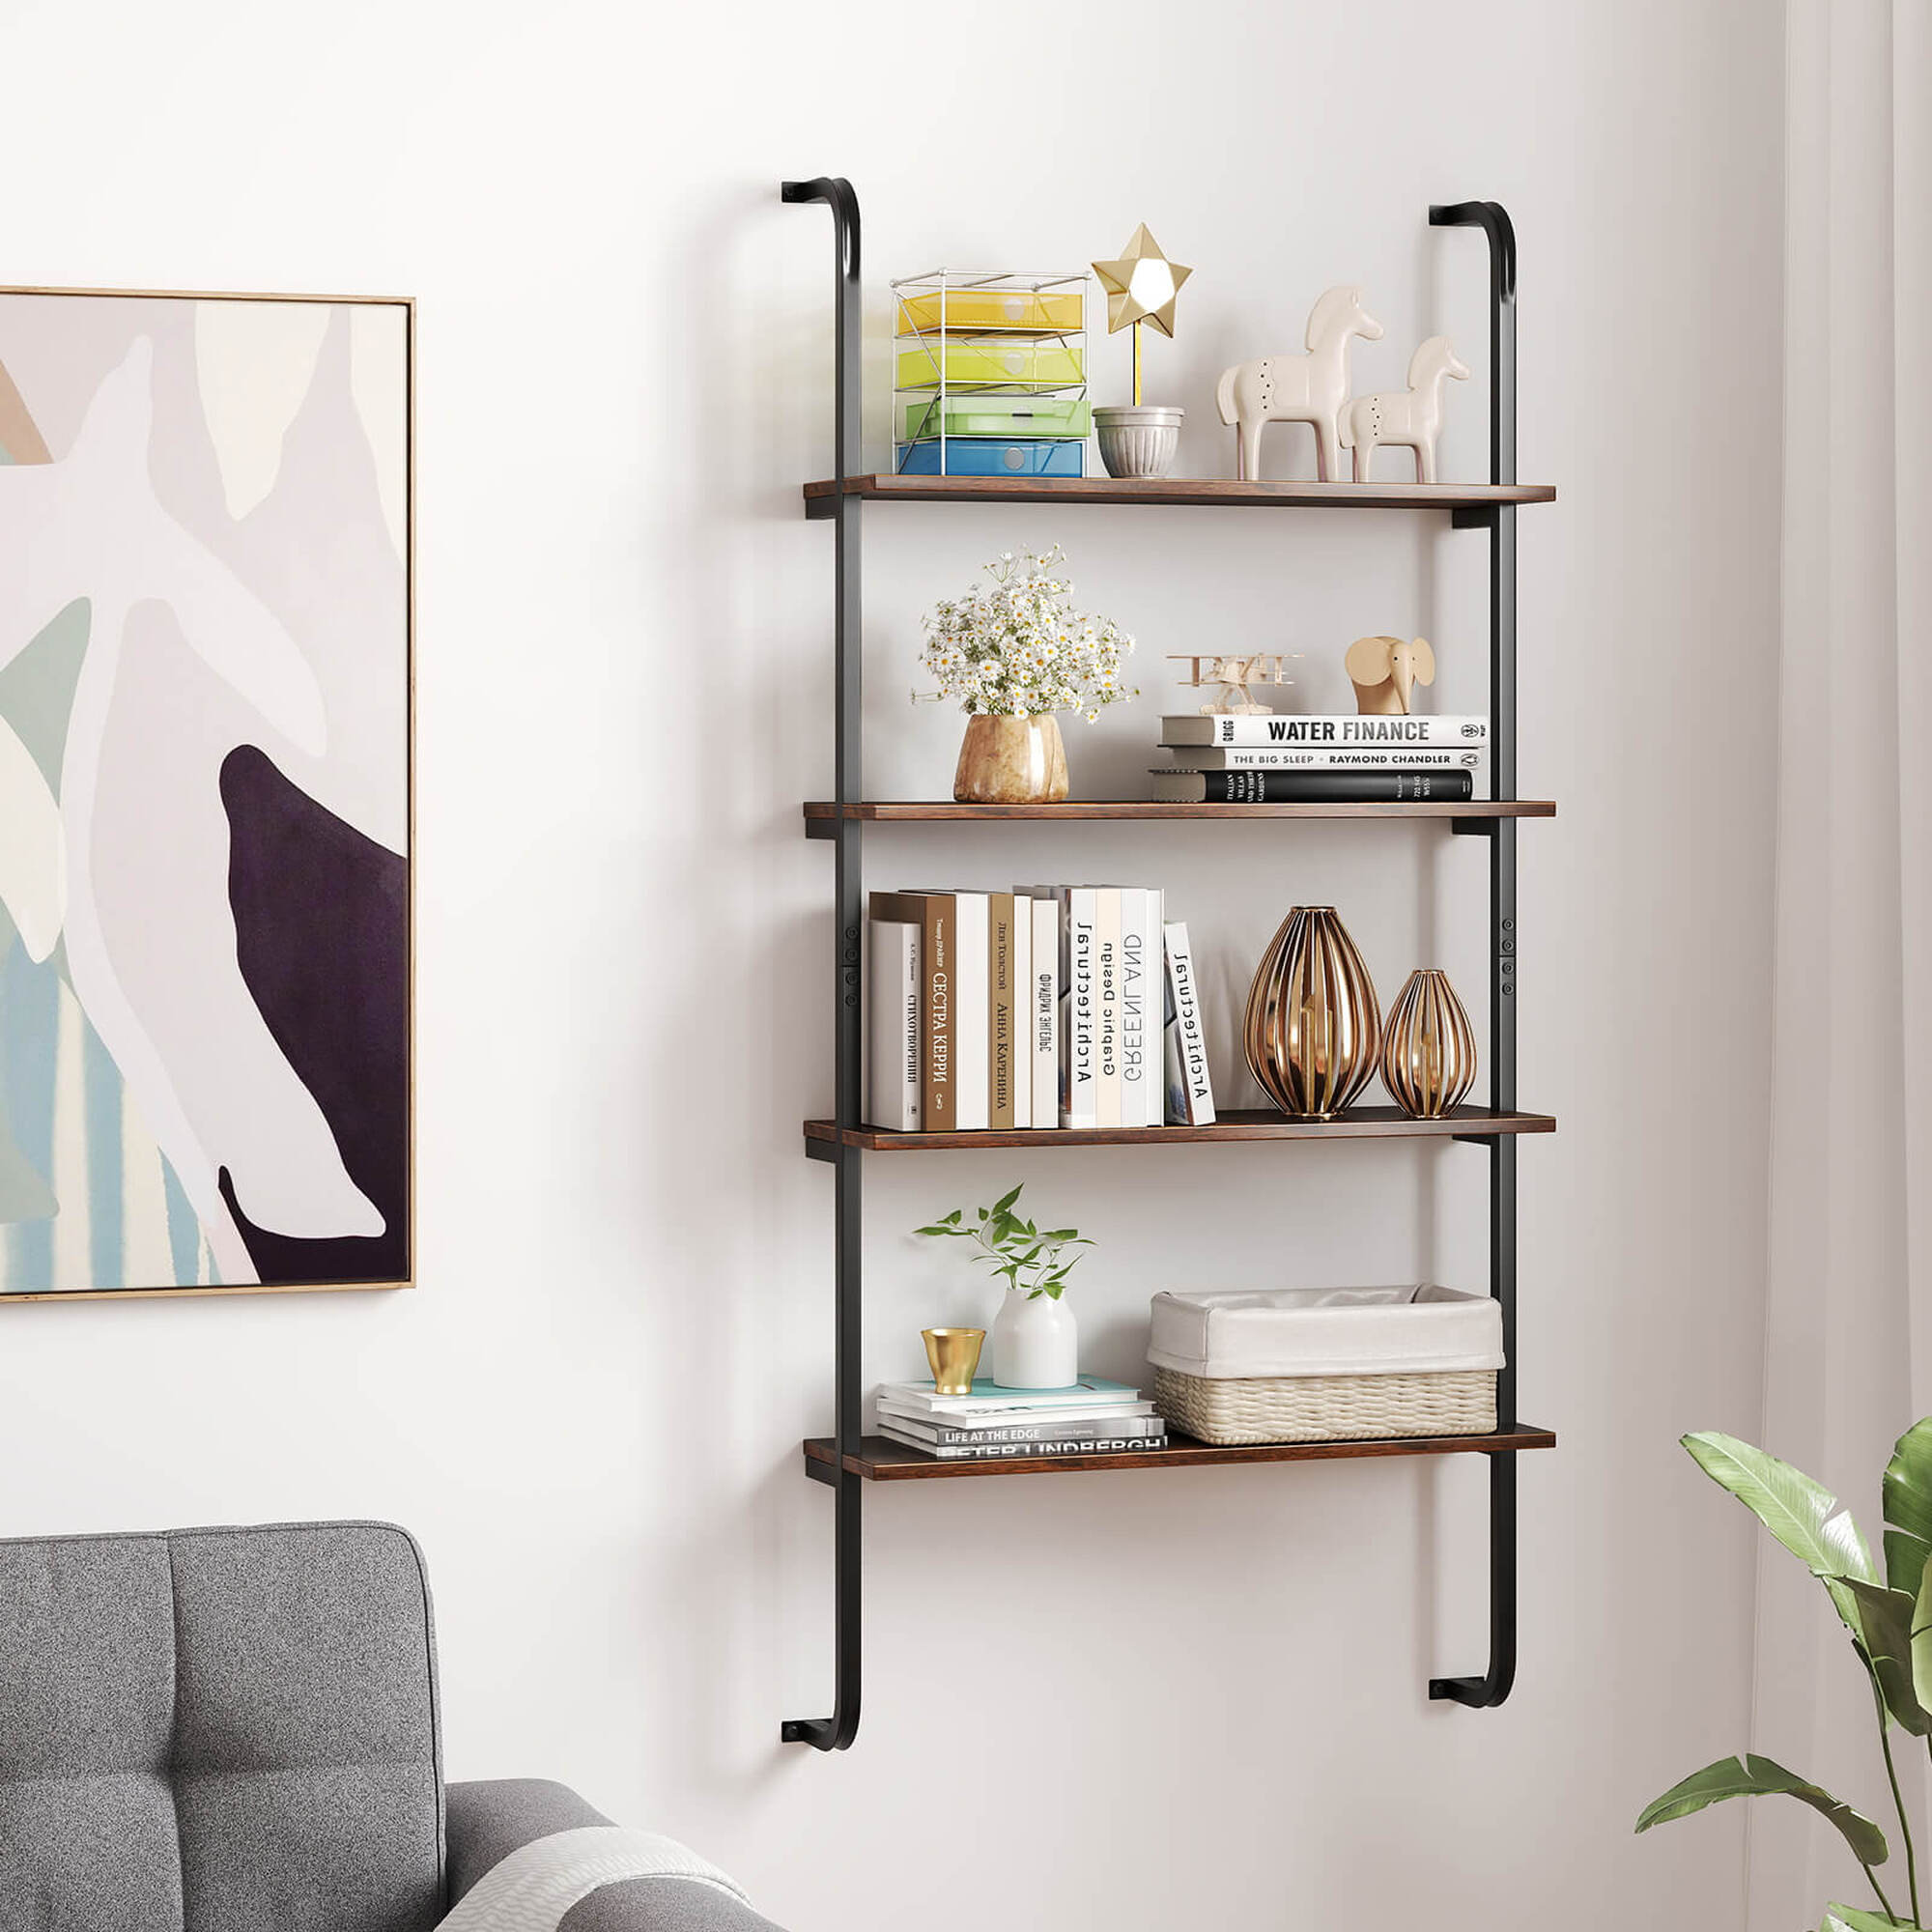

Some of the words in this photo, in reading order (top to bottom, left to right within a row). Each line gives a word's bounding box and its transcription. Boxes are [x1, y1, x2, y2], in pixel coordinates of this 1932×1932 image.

[1267, 722, 1335, 741] WATER
[1343, 722, 1430, 741] FINANCE
[1234, 755, 1254, 764] THE
[1258, 755, 1279, 764] BIG
[1283, 755, 1315, 764] SLEEP
[1329, 755, 1388, 764] RAYMOND
[1391, 755, 1451, 764] CHANDLER
[932, 972, 948, 1031] СЕСТРА
[1037, 974, 1052, 1013] ФРИДРИХ
[1037, 1016, 1052, 1052] ЭНГЕЛЬС
[933, 1035, 948, 1083] КЕРРИ
[945, 1432, 969, 1443] LIFE
[970, 1432, 984, 1442] AT
[986, 1430, 1009, 1441] THE
[1010, 1429, 1040, 1440] EDGE
